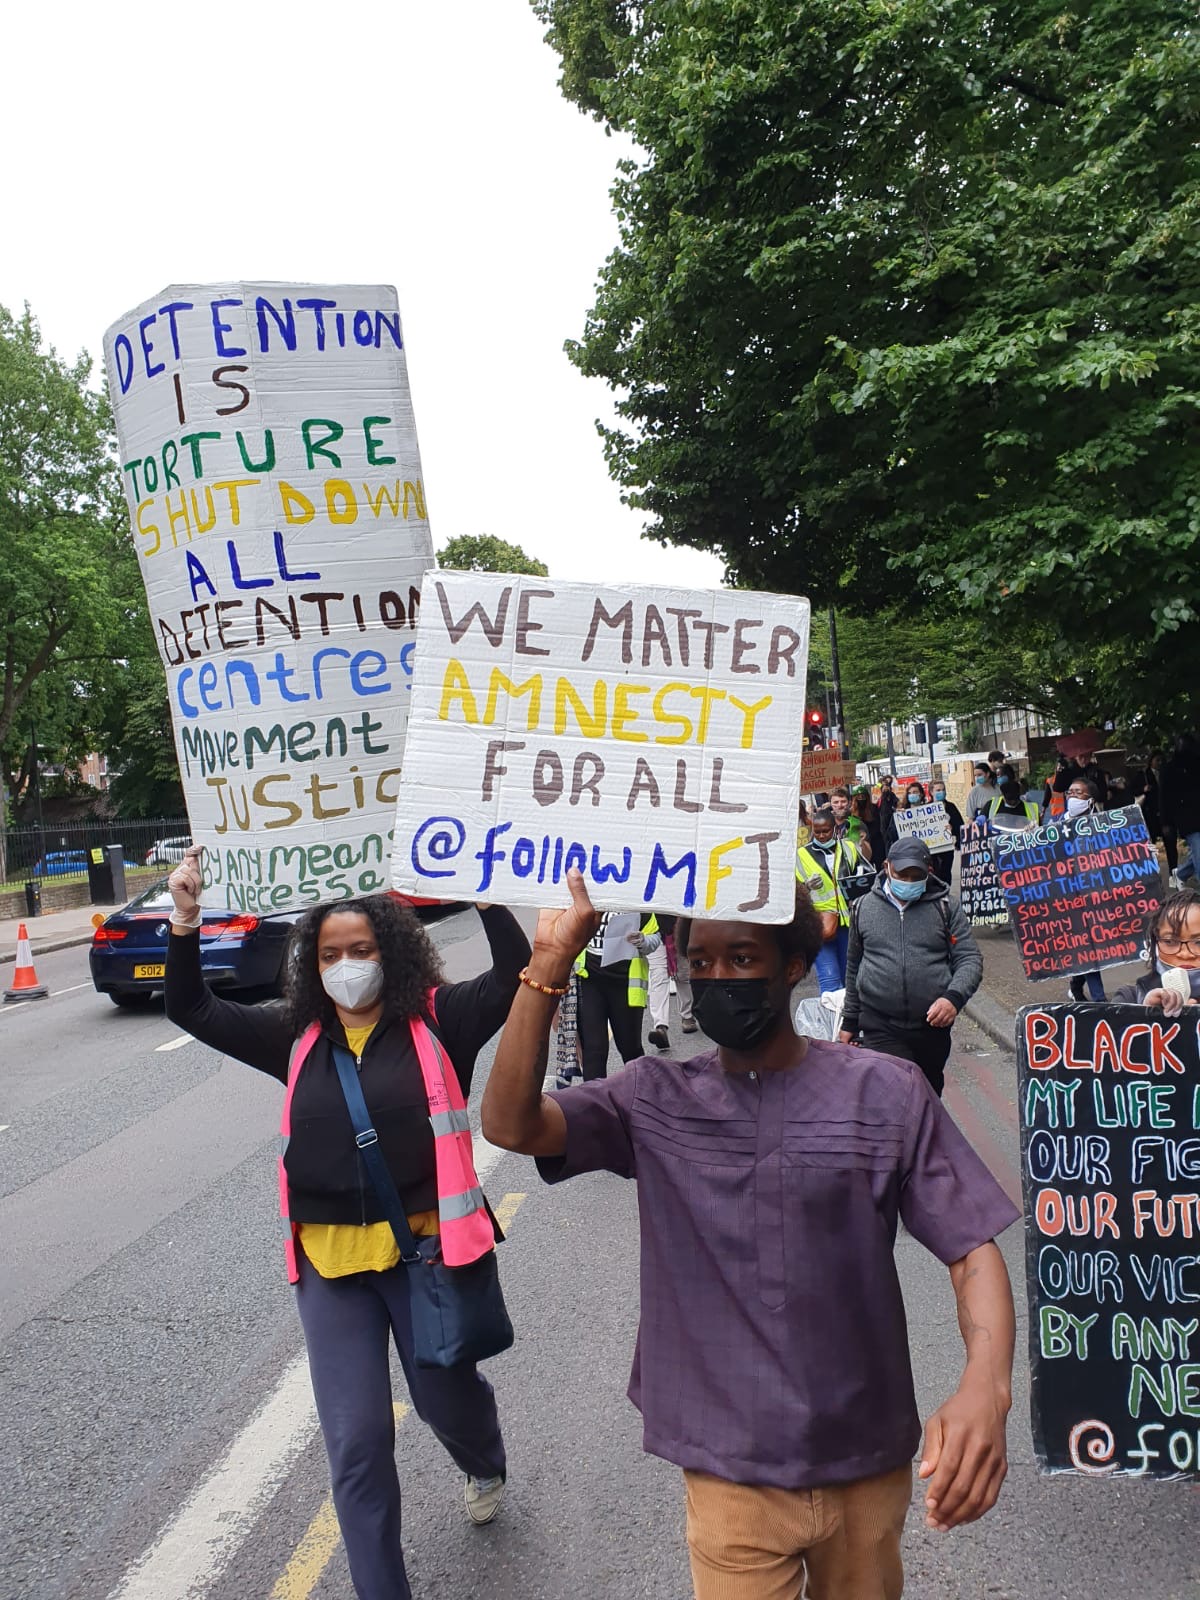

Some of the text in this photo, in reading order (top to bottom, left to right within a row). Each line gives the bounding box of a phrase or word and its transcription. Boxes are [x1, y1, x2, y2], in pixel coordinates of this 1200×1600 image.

[114, 296, 403, 394] DETENTION
[173, 365, 250, 425] IS
[124, 416, 397, 502] TORTURE
[136, 478, 427, 556] SHUT DOWN
[186, 531, 321, 601] ALL
[435, 581, 801, 677] WE MATTER
[438, 657, 773, 749] AMNESTY
[481, 740, 749, 813] FOR ALL
[896, 804, 943, 820] NO MORE
[911, 826, 940, 840] RAIDS
[996, 825, 1060, 855] SERCO
[1075, 809, 1128, 836] G4S
[969, 851, 991, 867] AND
[997, 843, 1058, 871] GUILTY
[1001, 840, 1151, 889] GUILTY OF BRUTALITY
[1005, 858, 1160, 904] SHUT THEM DOWN
[1018, 902, 1049, 921] Say
[1053, 894, 1089, 913] their
[1023, 918, 1144, 956] Christine Chase
[1025, 1012, 1186, 1076] BLACK
[1025, 1077, 1082, 1128] MY
[1093, 1078, 1176, 1129] LIFE
[1027, 1129, 1113, 1186] OUR
[1035, 1187, 1200, 1241] OUR FUT
[1038, 1244, 1200, 1304] OUR VIC
[1039, 1305, 1199, 1362] BY ANY
